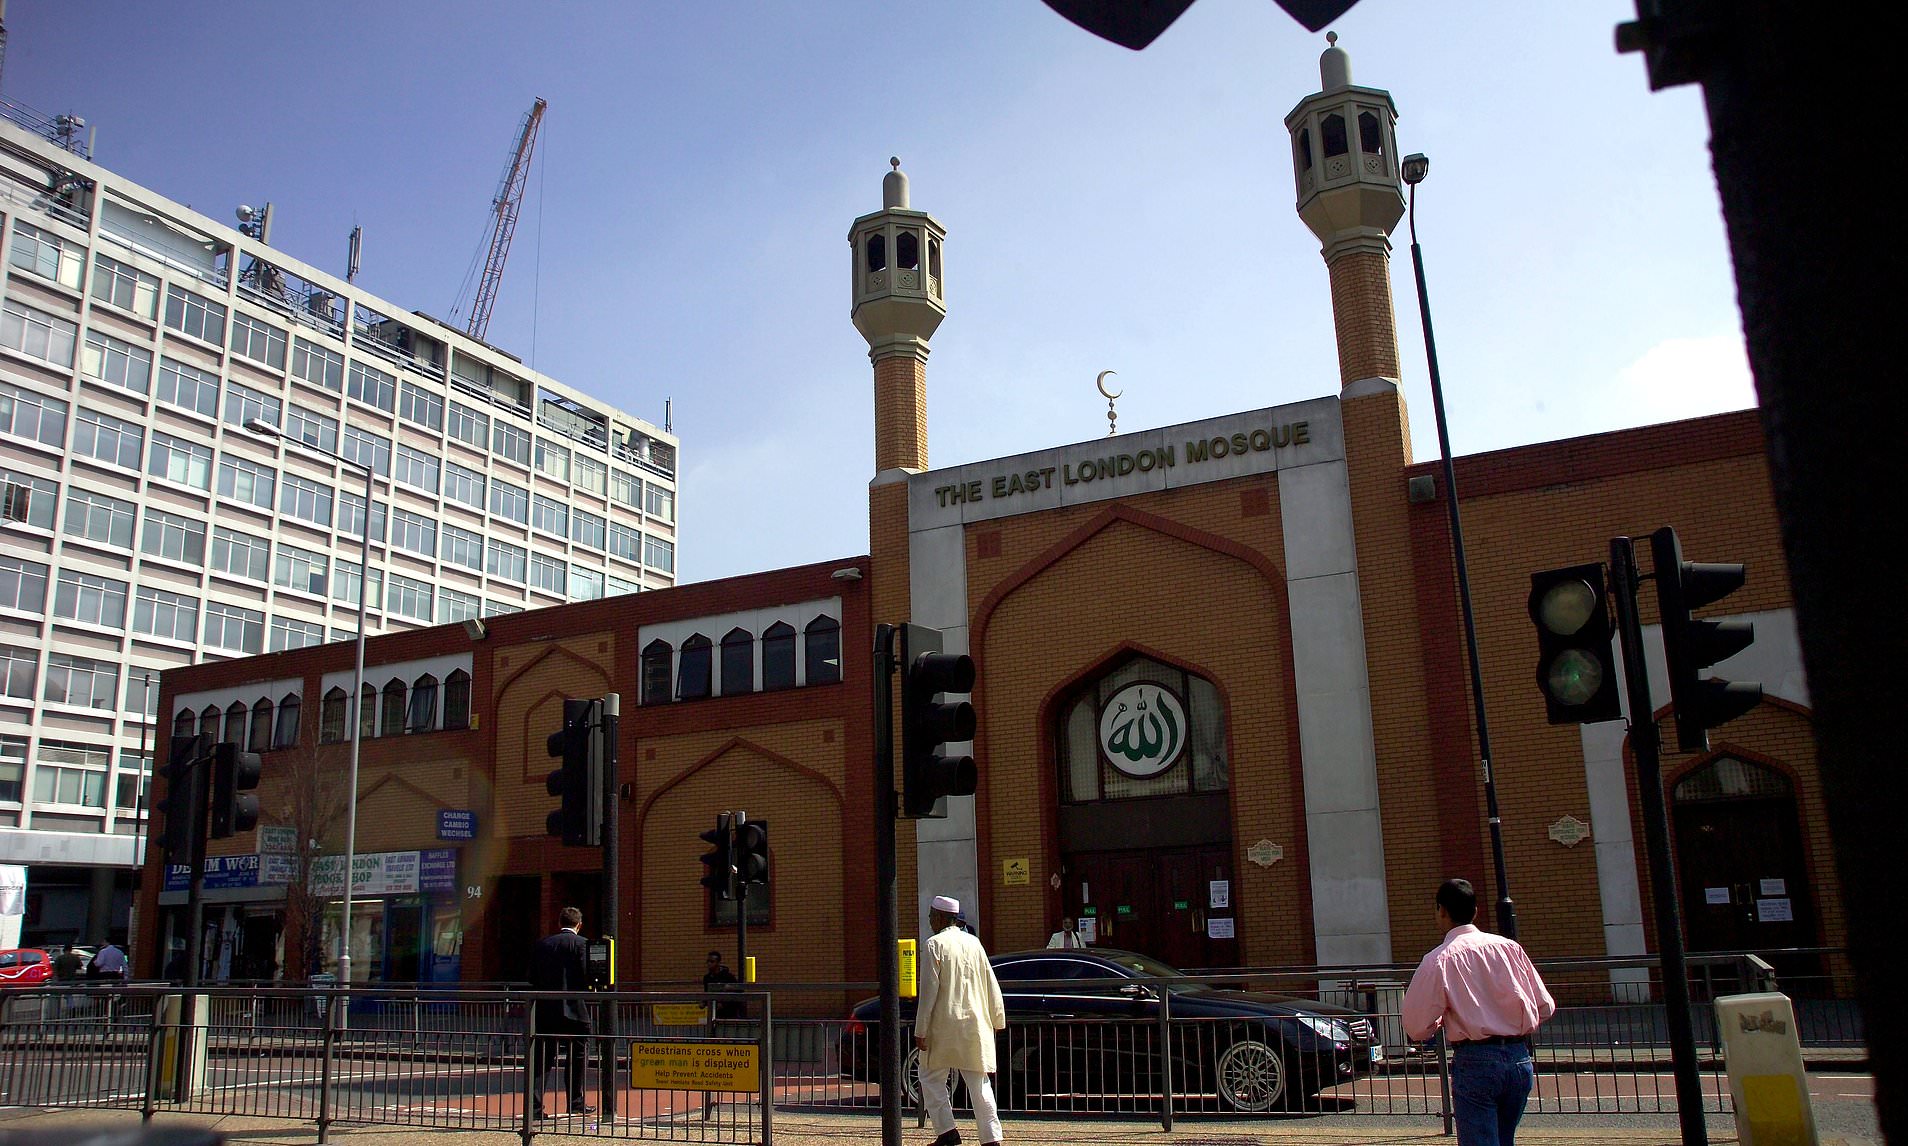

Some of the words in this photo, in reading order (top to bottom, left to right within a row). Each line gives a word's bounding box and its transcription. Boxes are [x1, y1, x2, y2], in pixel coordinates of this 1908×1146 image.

[935, 480, 983, 508] THE
[991, 466, 1056, 499] EAST
[1063, 445, 1175, 486] LONDON
[1185, 421, 1311, 464] MOSQUE
[443, 821, 470, 830] CAMBIO
[440, 829, 473, 838] WECHSEL
[171, 857, 221, 875] DEIM
[336, 857, 380, 871] LNDON
[467, 886, 482, 899] 94
[638, 1045, 692, 1056] Pedestrians
[696, 1047, 721, 1056] cross
[725, 1048, 751, 1057] when
[640, 1058, 665, 1068] green
[669, 1059, 688, 1067] man
[692, 1059, 700, 1067] is
[704, 1059, 750, 1070] displayed
[655, 1070, 670, 1078] Help
[672, 1070, 697, 1078] Prevent
[700, 1071, 733, 1079] Accidents
